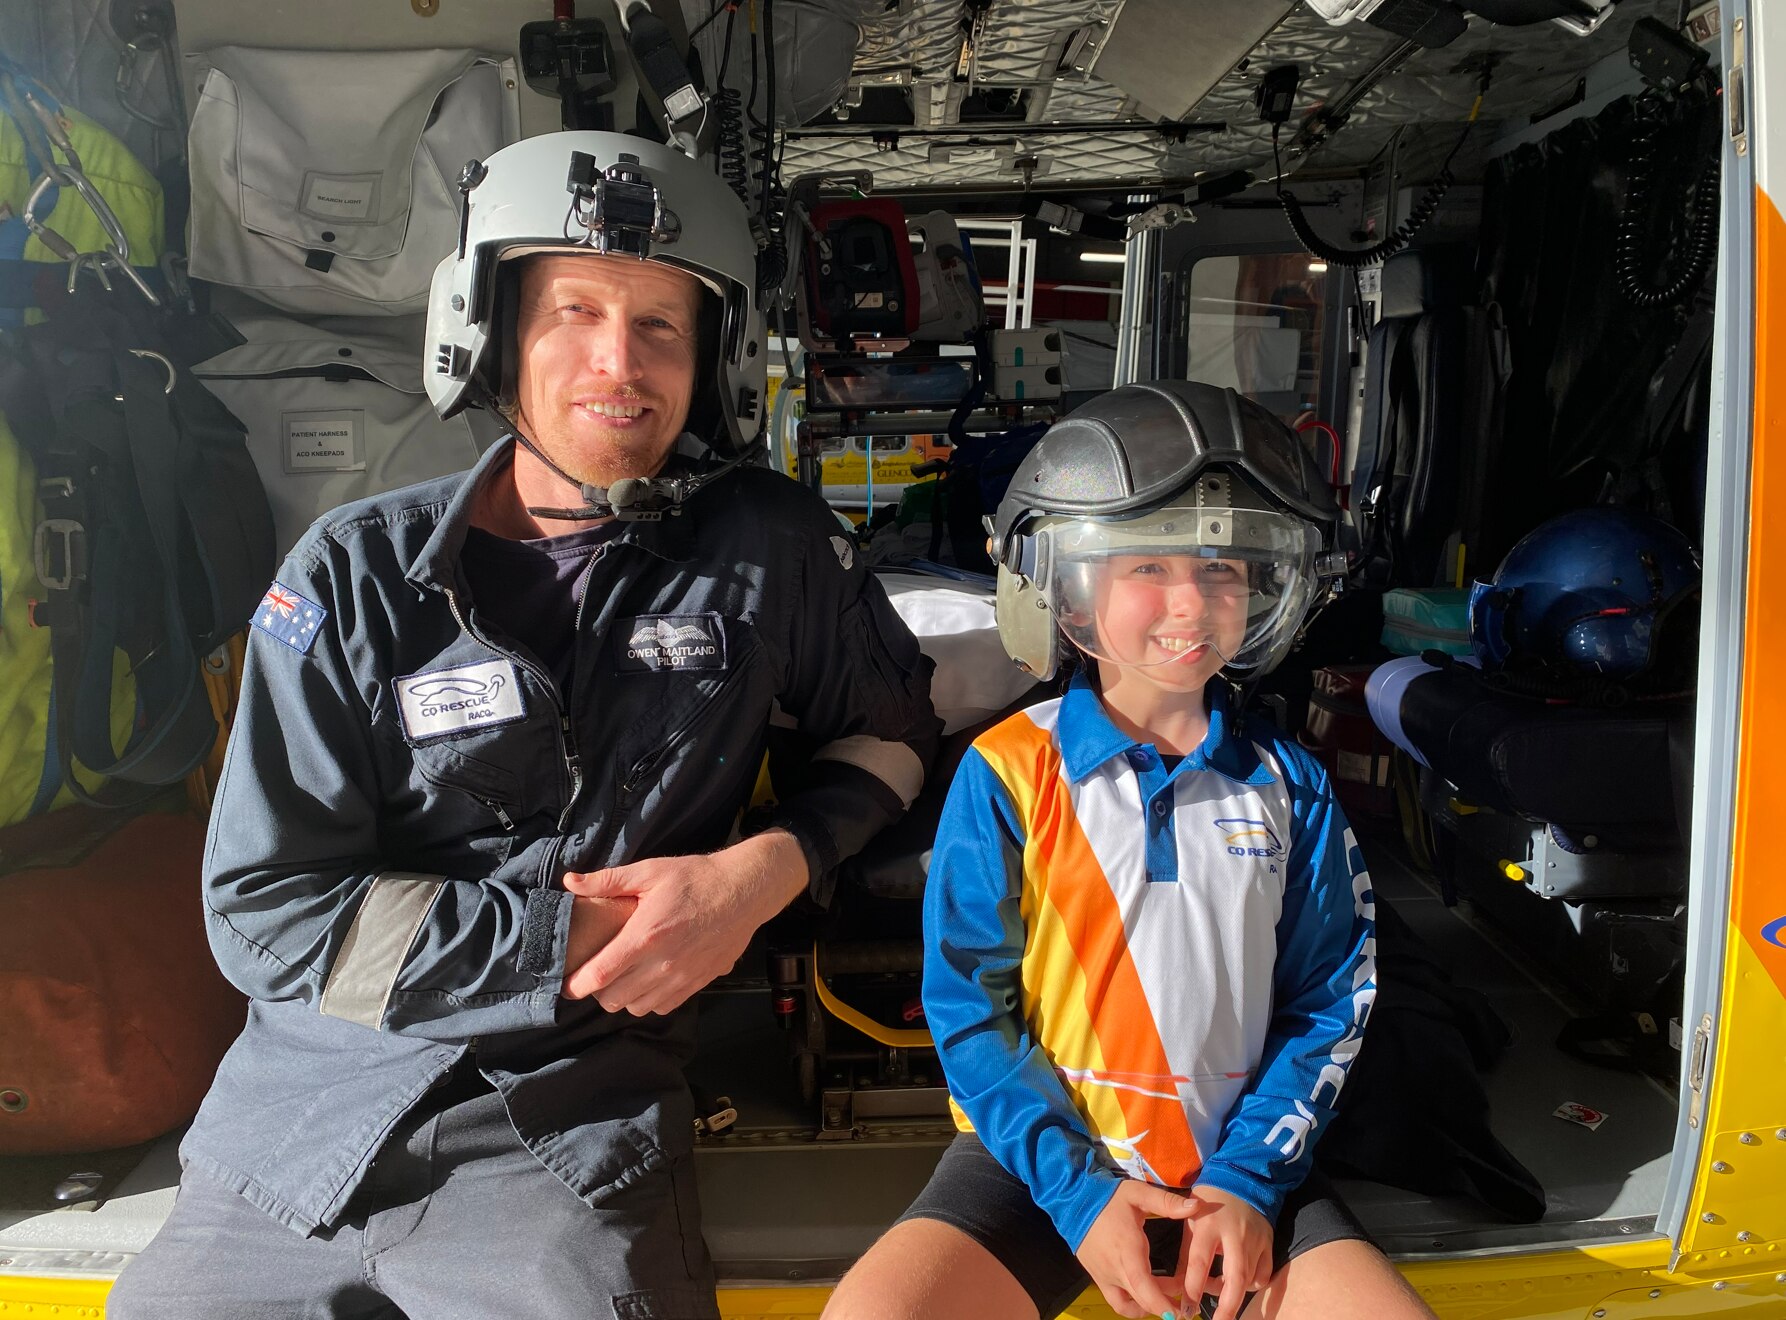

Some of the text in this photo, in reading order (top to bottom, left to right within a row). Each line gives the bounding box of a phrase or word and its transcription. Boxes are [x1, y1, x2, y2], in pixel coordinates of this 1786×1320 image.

[317, 195, 342, 203] SEARCH
[877, 469, 913, 478] GLENCO
[627, 645, 716, 659] OWEN MAITLAND
[656, 656, 687, 666] PILOT
[439, 695, 490, 713] RESCUE
[468, 709, 493, 721] RACQ
[1247, 847, 1275, 857] RES
